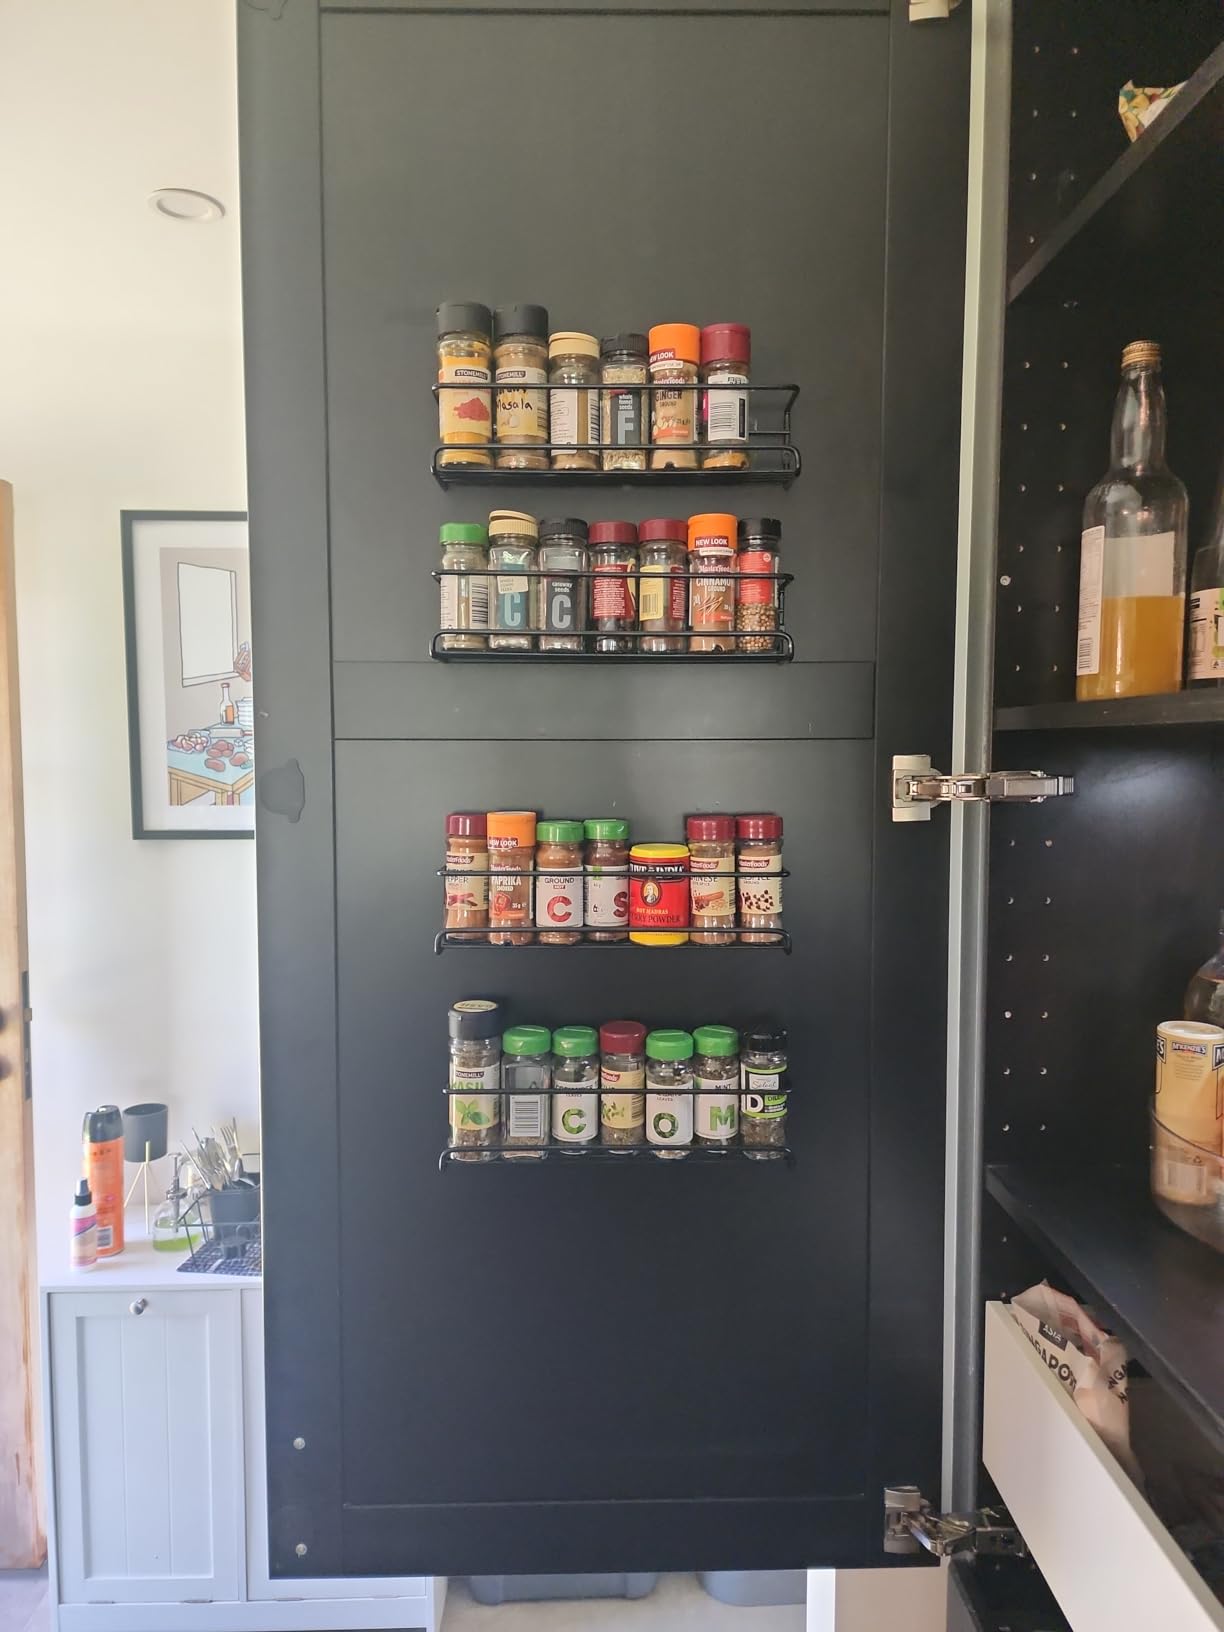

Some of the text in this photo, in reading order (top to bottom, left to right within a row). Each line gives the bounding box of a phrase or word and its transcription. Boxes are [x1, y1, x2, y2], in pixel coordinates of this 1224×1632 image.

[657, 351, 674, 360] LOOK
[655, 390, 682, 401] GINGER
[618, 410, 634, 445] F
[711, 538, 728, 546] LOOK
[504, 591, 521, 627] C
[551, 594, 572, 629] C
[547, 895, 572, 923] C
[709, 1103, 735, 1131] M
[746, 1094, 764, 1113] D
[561, 1107, 587, 1135] C
[652, 1111, 679, 1139] O
